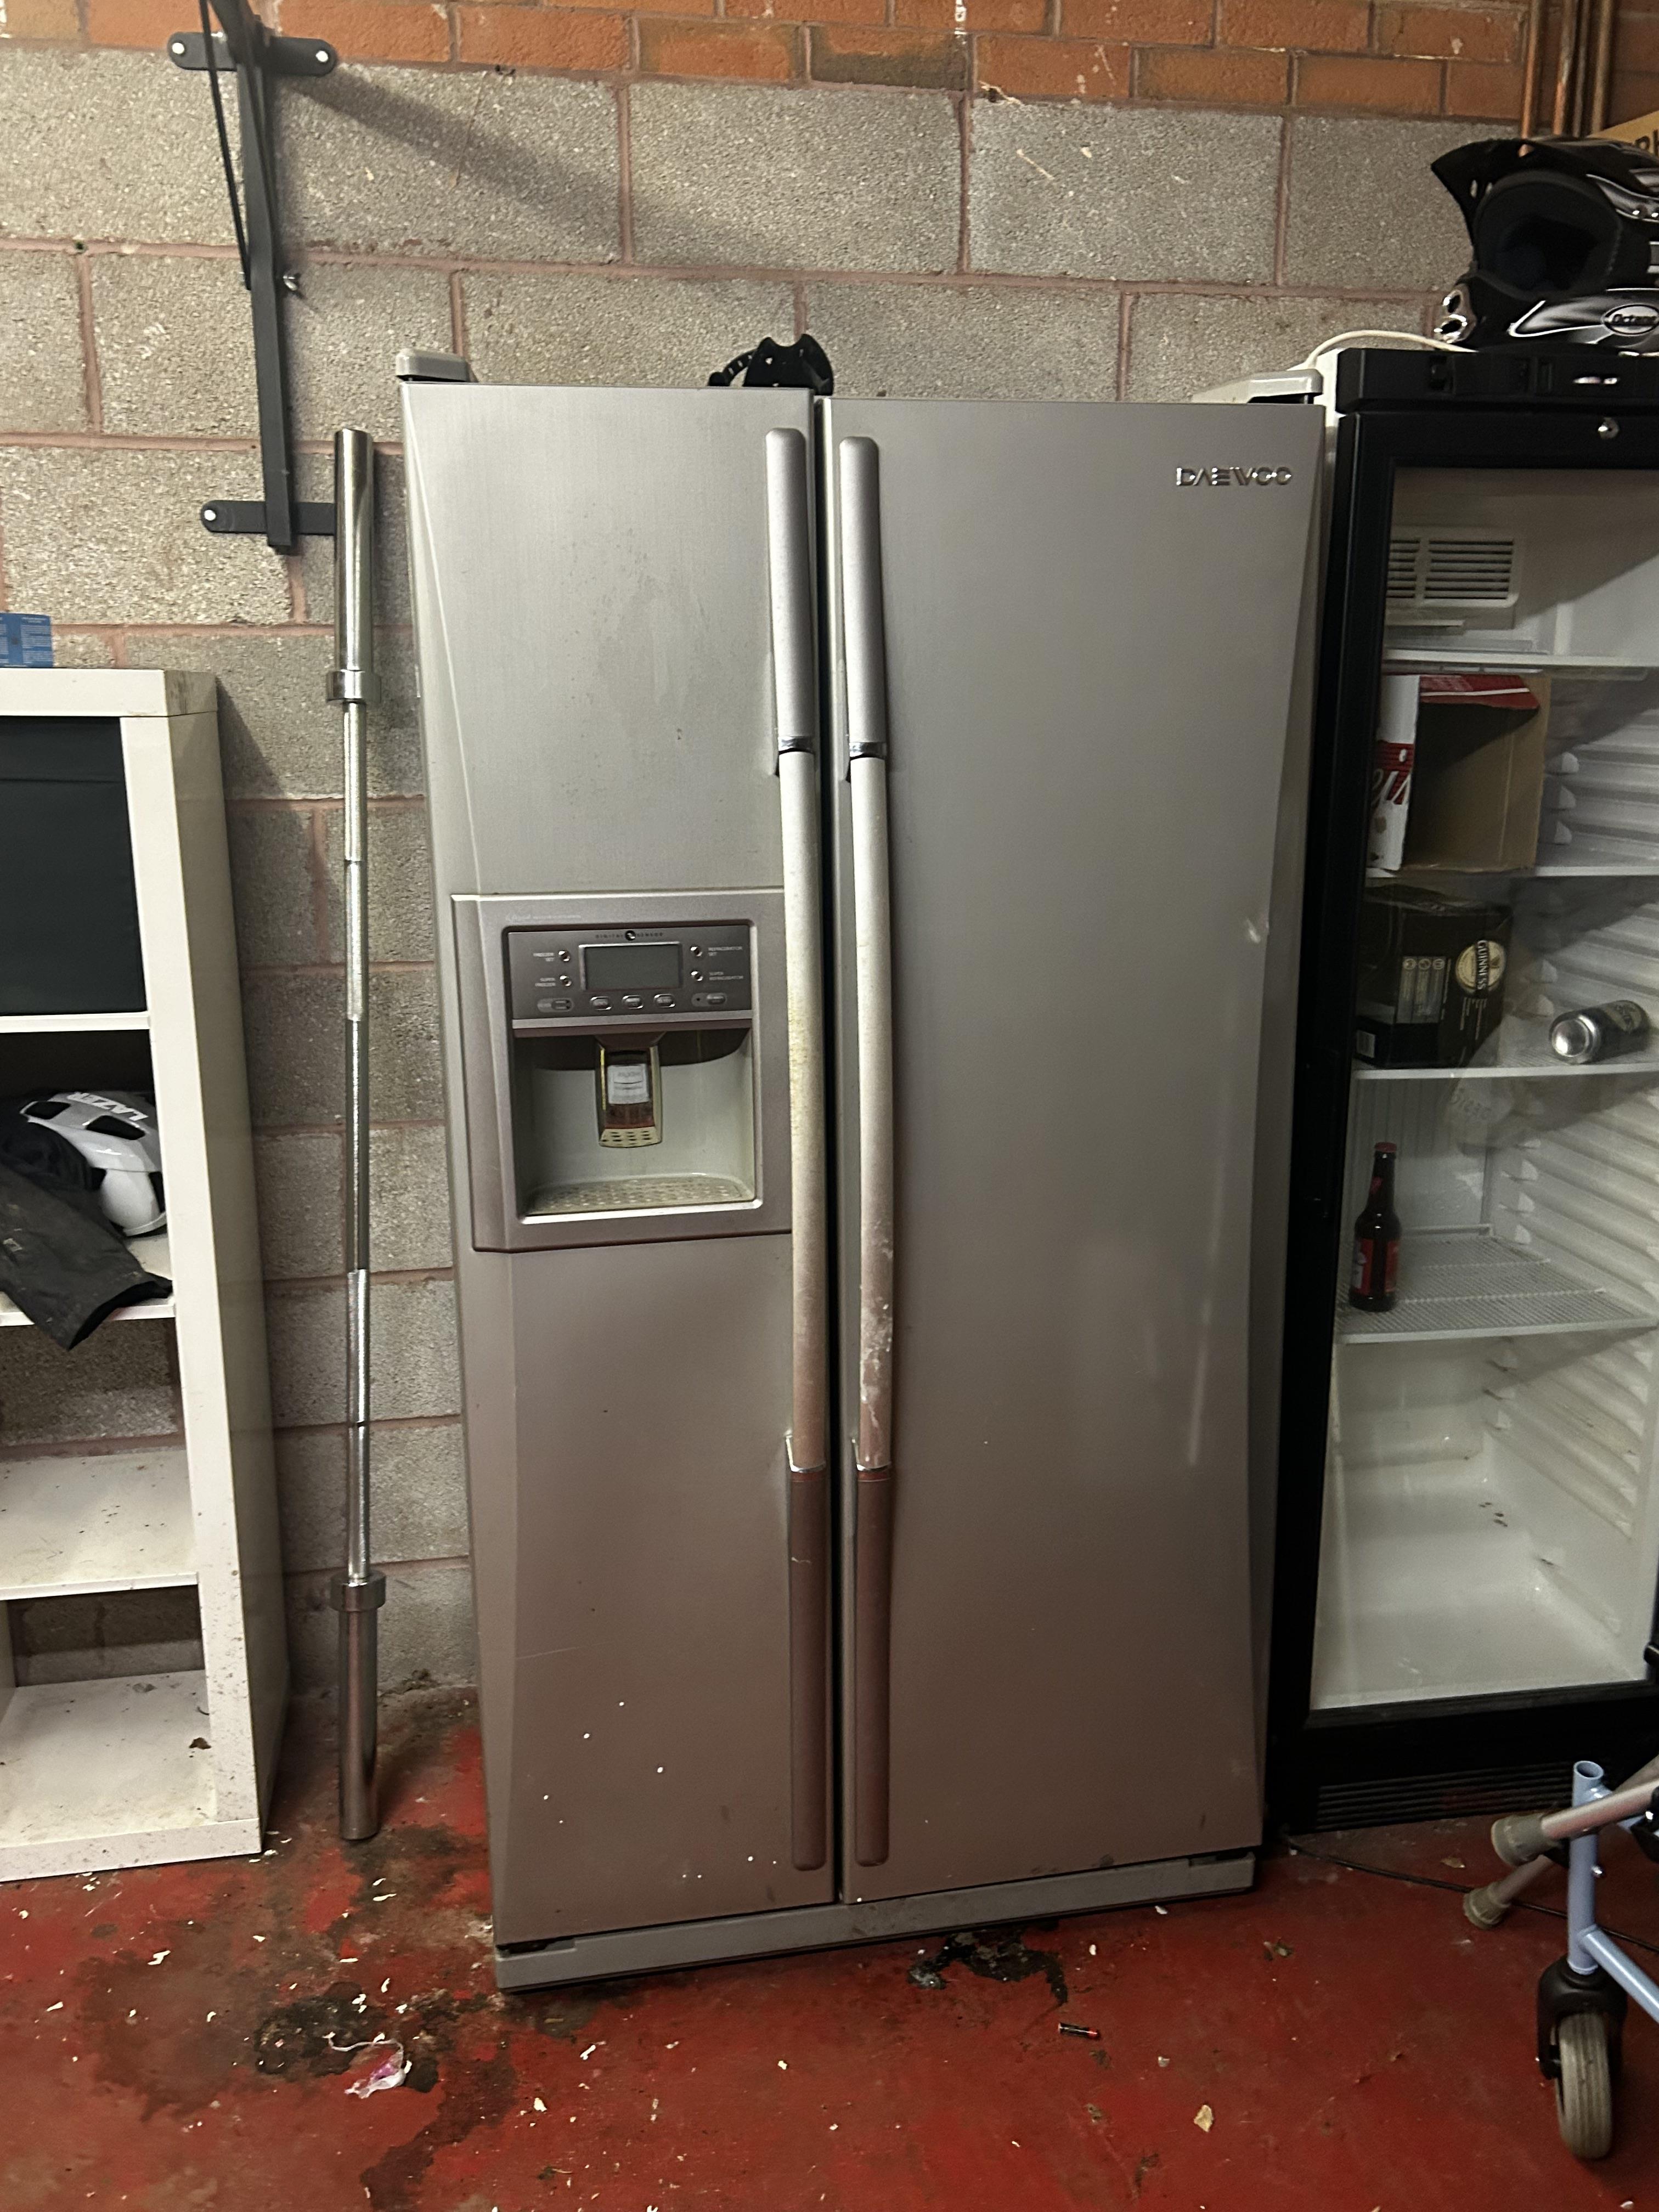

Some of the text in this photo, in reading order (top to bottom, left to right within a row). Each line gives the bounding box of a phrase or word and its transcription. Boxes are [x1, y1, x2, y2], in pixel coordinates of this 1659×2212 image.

[1176, 466, 1292, 486] DAEWOO
[1477, 940, 1488, 990] GUINNESS
[66, 1092, 149, 1121] LAZER
